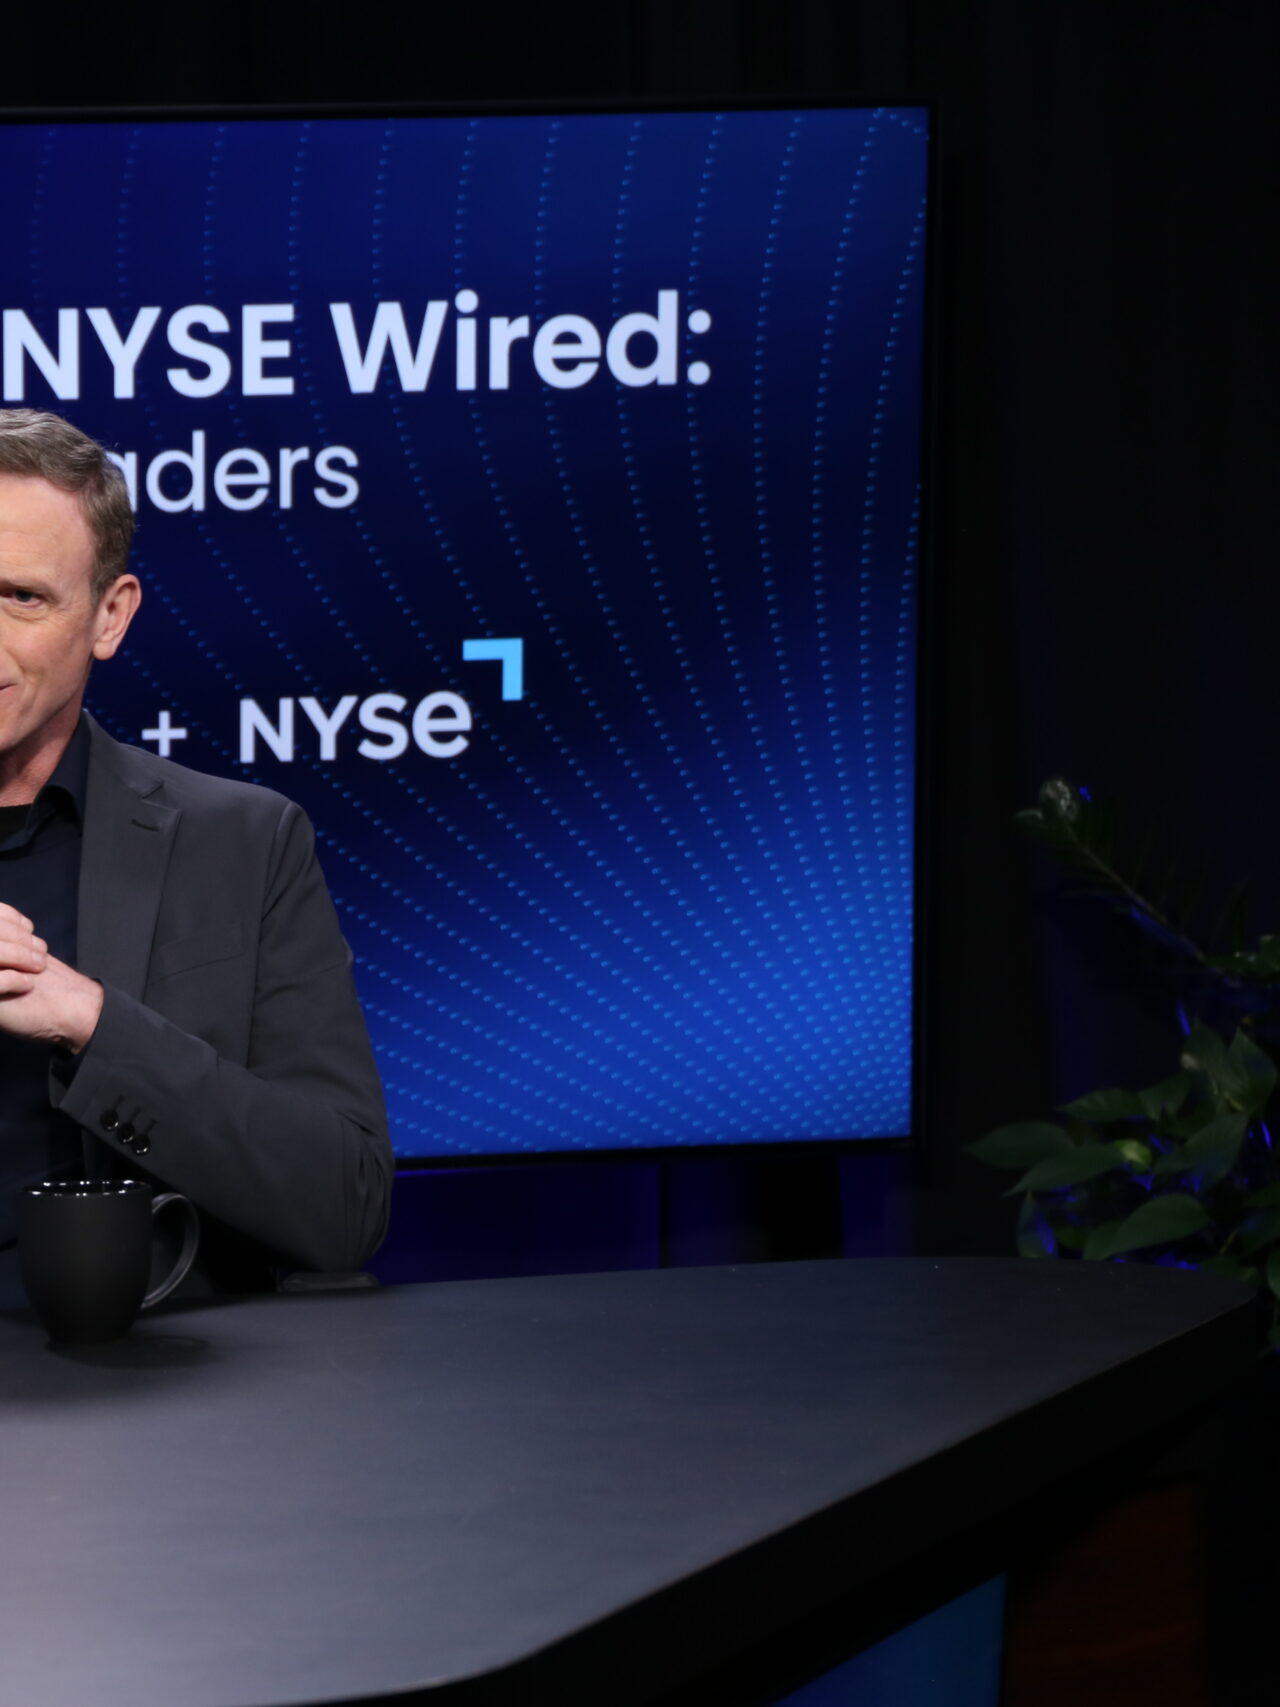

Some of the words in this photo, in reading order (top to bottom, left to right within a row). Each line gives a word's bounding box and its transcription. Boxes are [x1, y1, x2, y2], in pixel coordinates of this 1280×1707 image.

[2, 303, 295, 402] NYSE
[329, 289, 711, 393] Wired:
[141, 710, 187, 757] +
